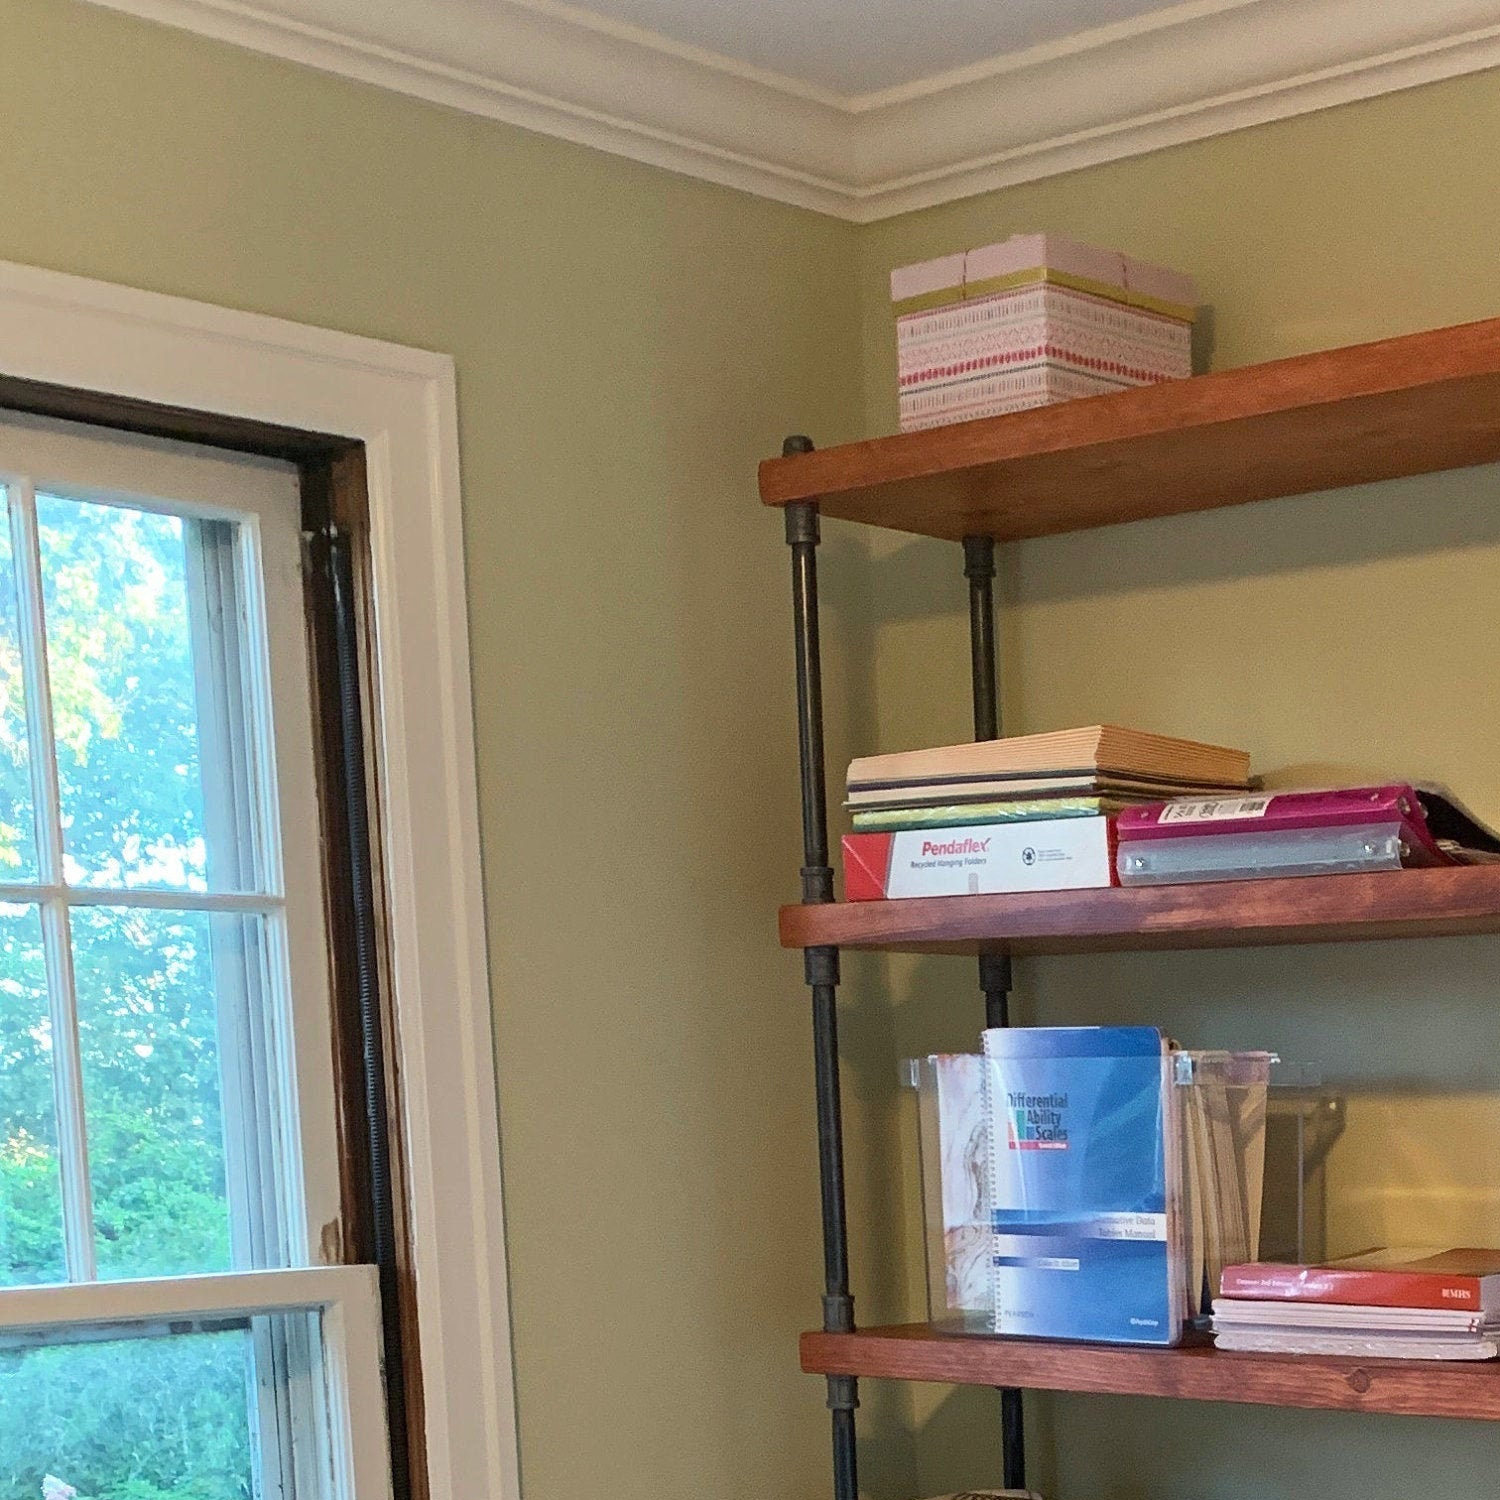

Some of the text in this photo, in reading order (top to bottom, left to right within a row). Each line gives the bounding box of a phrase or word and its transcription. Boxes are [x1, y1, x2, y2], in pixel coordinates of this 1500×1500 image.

[922, 837, 991, 856] Pendaflex
[965, 857, 986, 866] Folders
[1007, 1092, 1068, 1108] Differential
[1027, 1109, 1061, 1128] Ability
[1035, 1125, 1068, 1140] Scales
